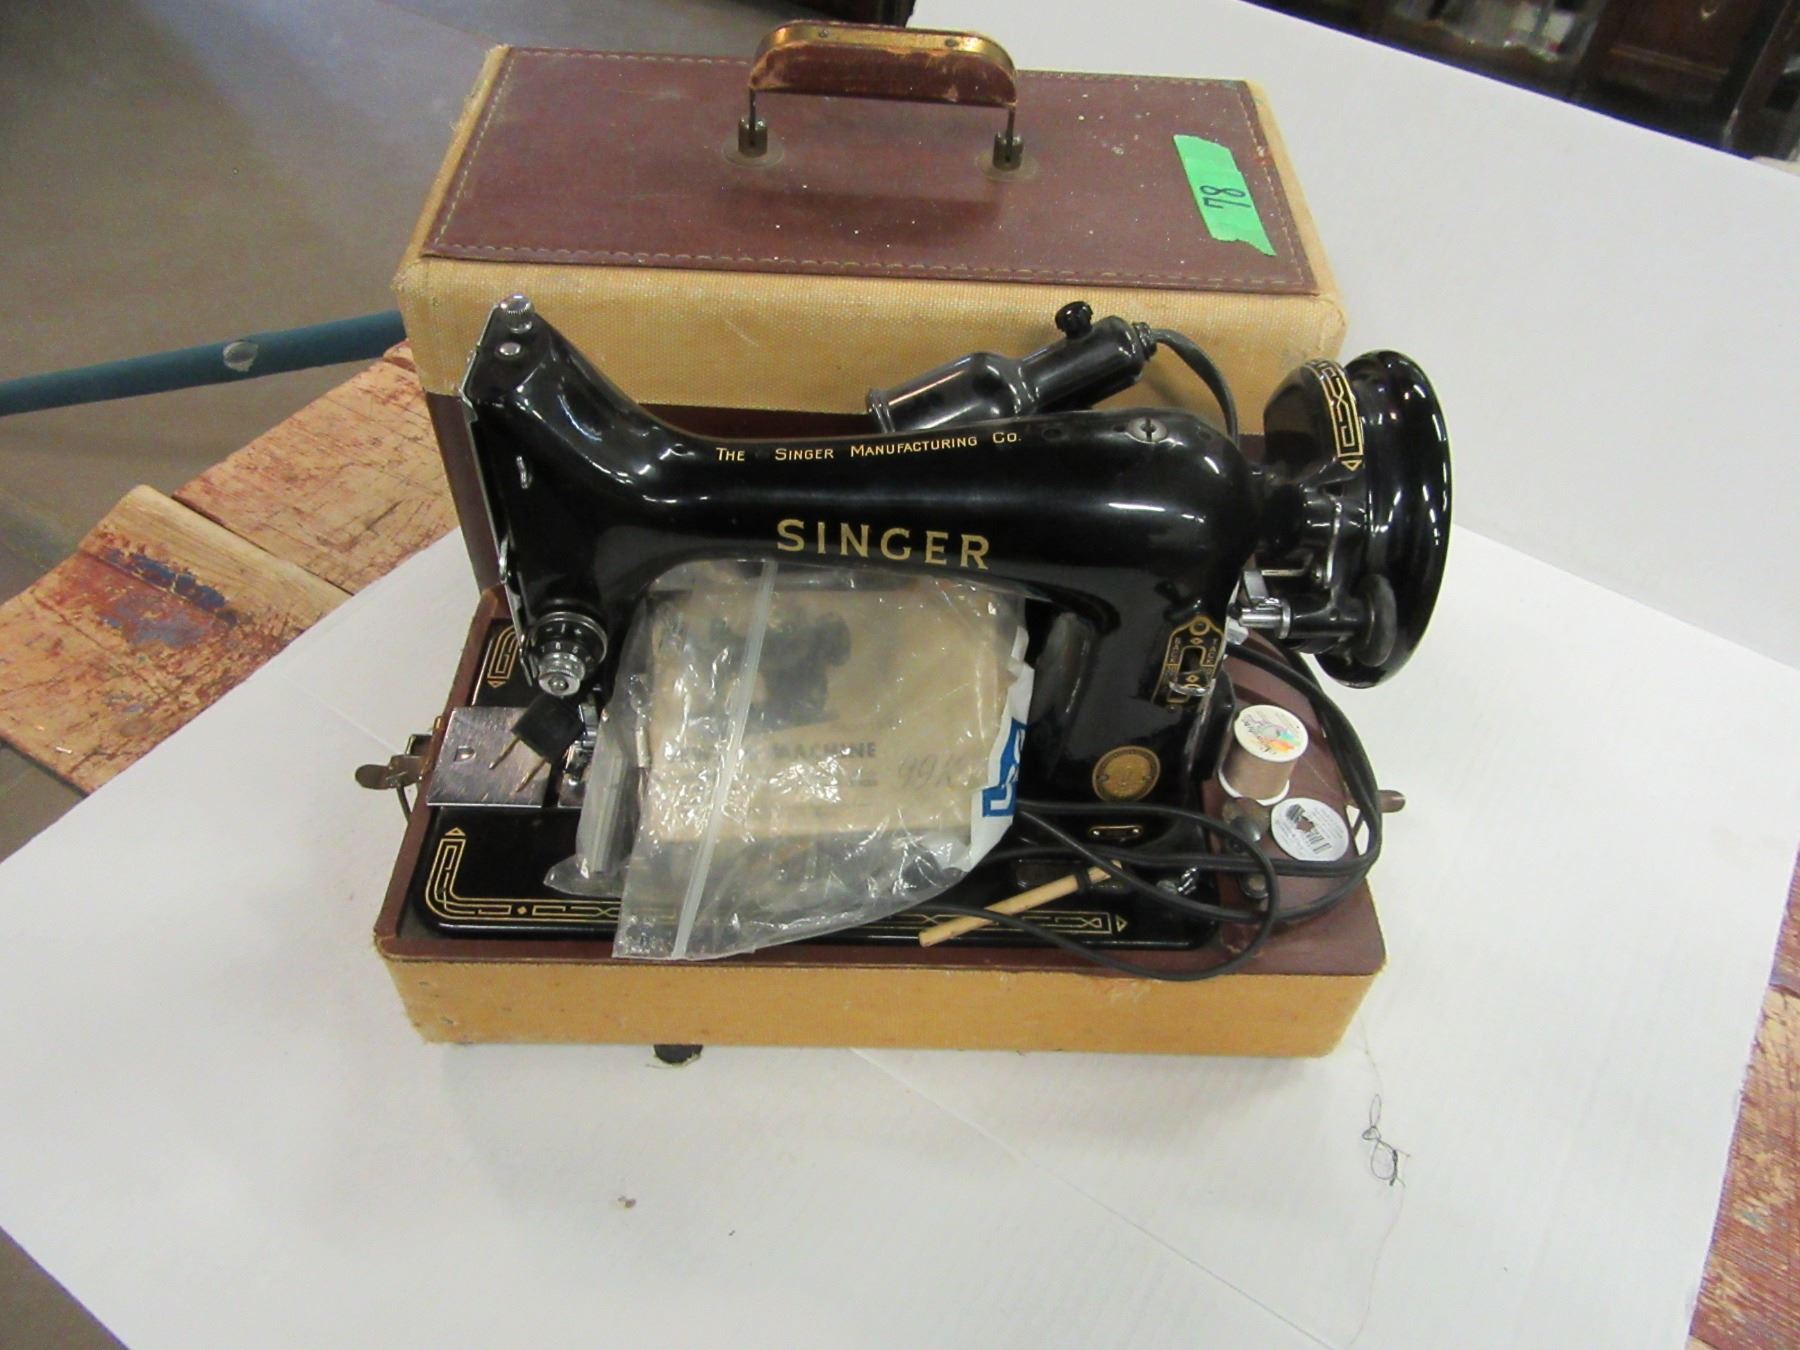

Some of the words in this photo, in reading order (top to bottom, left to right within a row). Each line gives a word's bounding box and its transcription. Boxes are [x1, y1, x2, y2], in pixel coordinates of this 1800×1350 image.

[1200, 185, 1252, 209] 78
[715, 447, 745, 461] THE
[775, 447, 834, 461] SINGER
[850, 436, 978, 457] MANUFACTURING
[776, 518, 990, 570] SINGER
